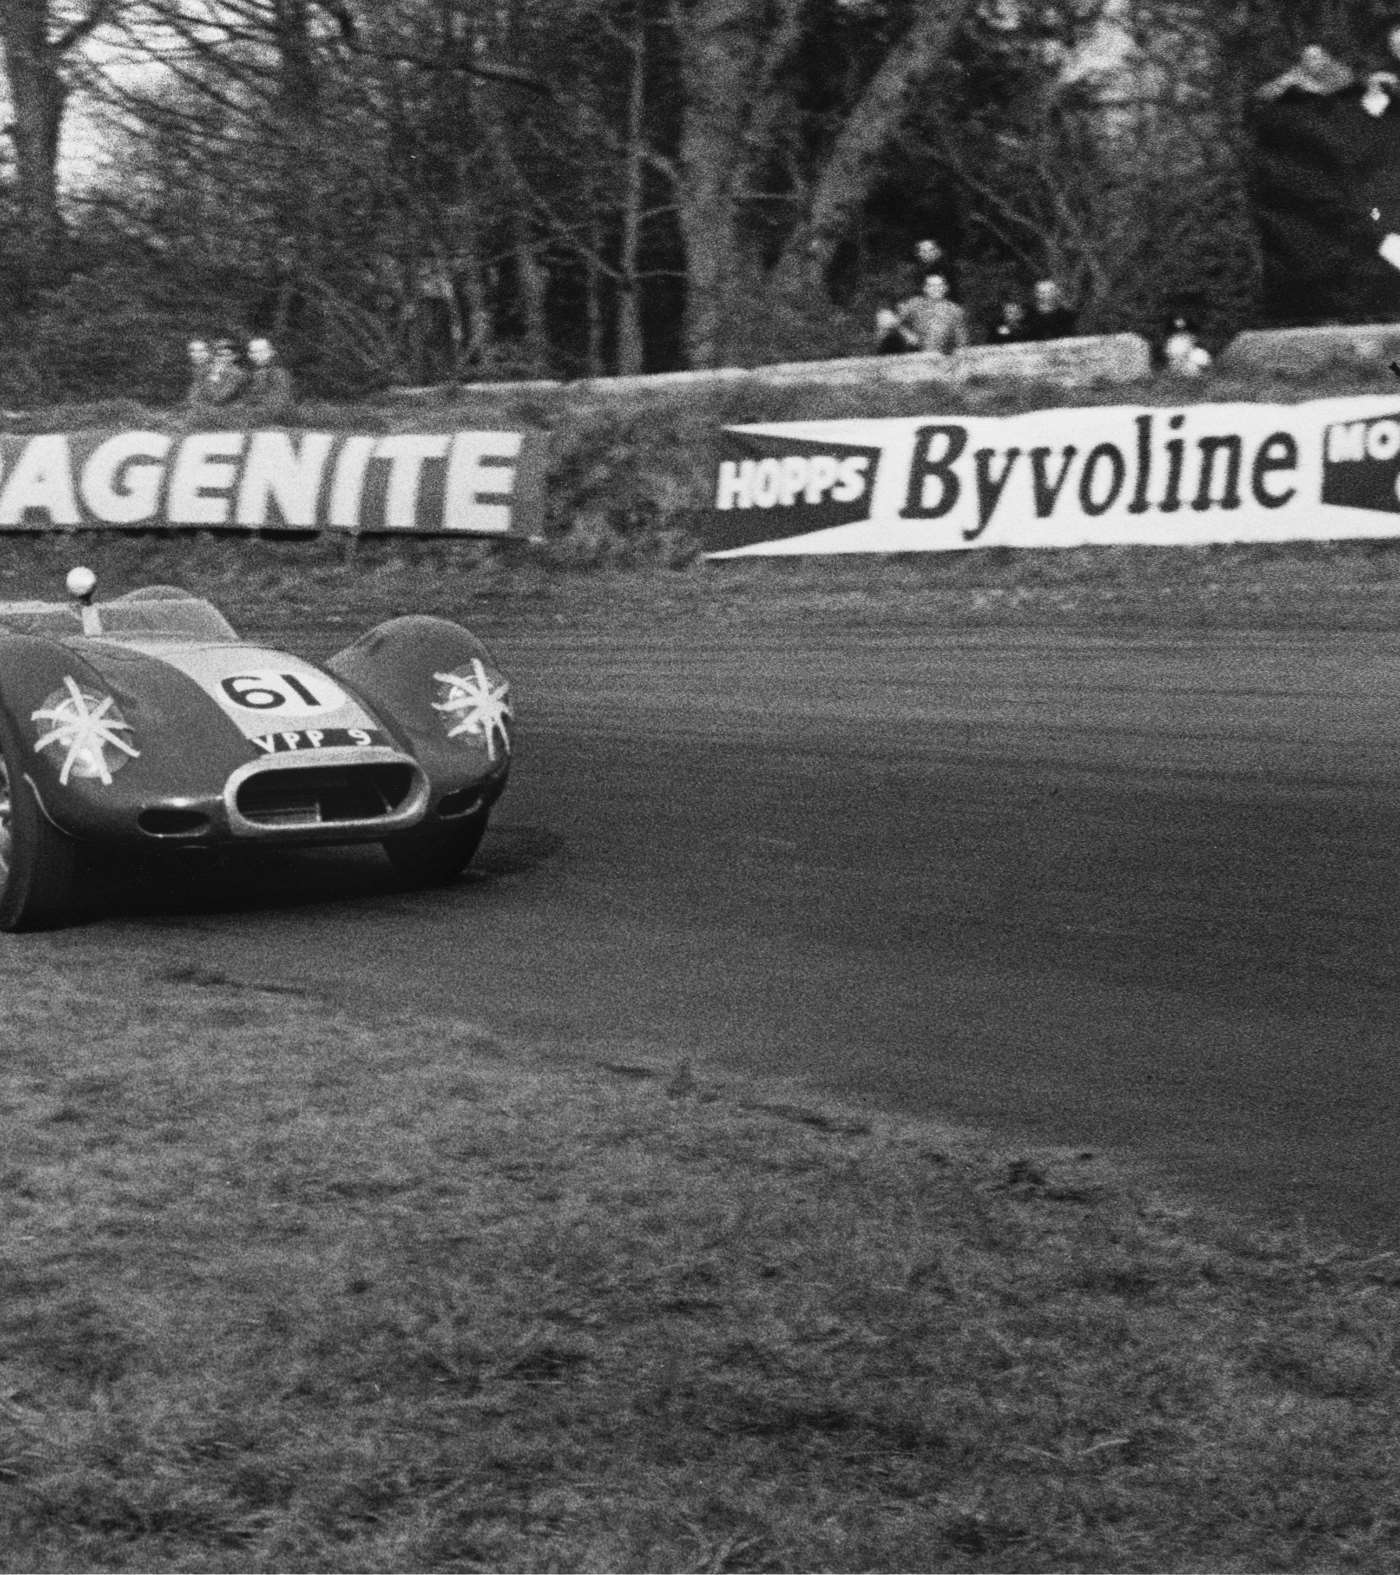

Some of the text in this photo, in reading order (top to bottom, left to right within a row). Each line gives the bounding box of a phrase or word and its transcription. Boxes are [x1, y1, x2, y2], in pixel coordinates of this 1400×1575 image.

[716, 455, 869, 510] HOPPS
[898, 414, 1298, 541] Byvoline
[220, 674, 322, 710] 61
[250, 729, 324, 754] VPP
